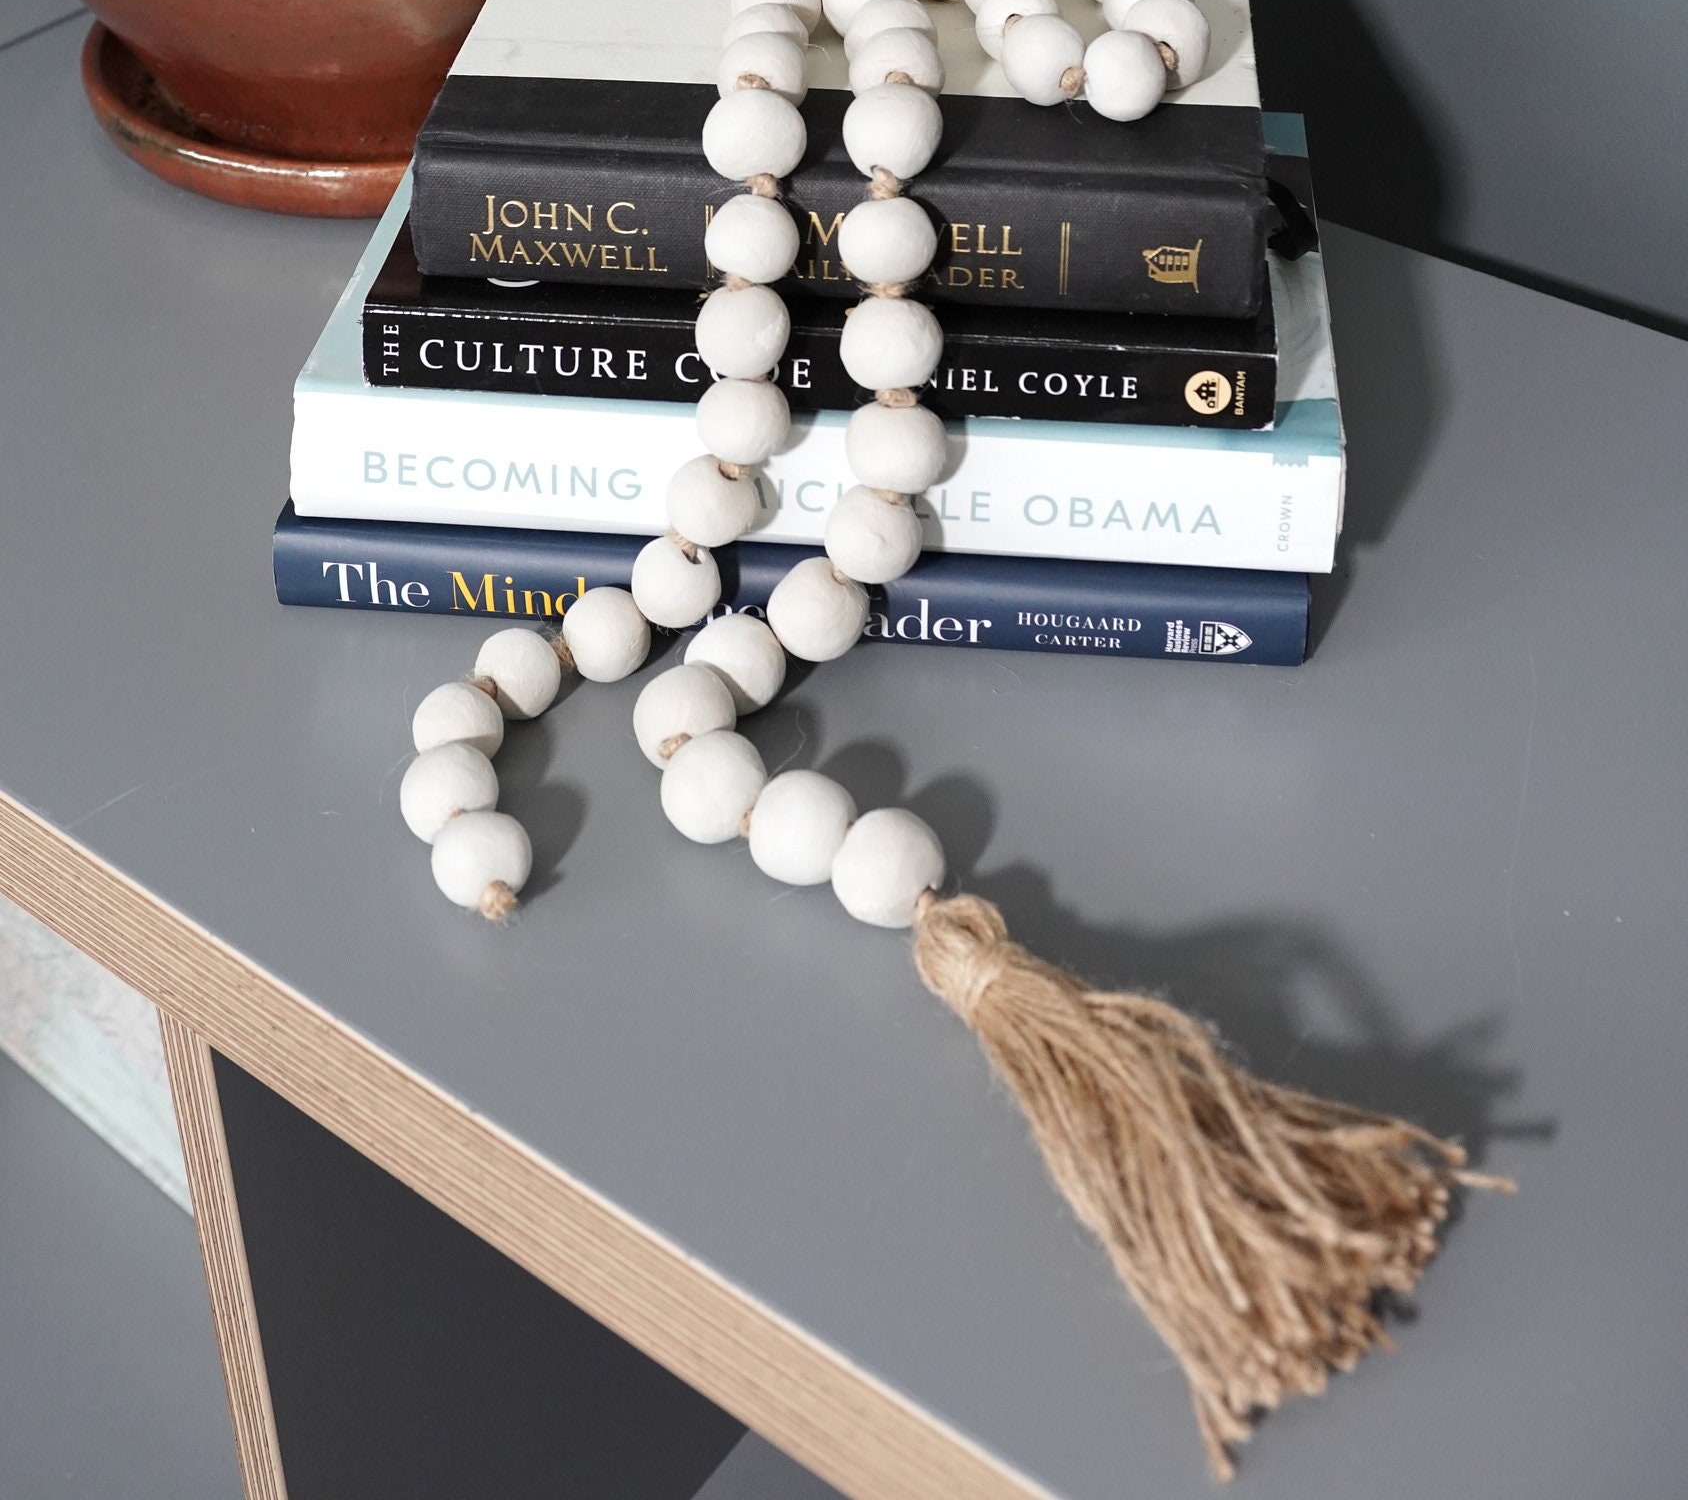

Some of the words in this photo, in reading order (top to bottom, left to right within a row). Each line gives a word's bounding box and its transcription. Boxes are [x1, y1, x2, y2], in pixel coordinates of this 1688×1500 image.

[482, 195, 593, 235] JOHN
[606, 202, 649, 236] C.
[469, 233, 668, 273] MAXWELL
[383, 324, 399, 376] THE
[419, 339, 648, 380] CULTURE
[675, 352, 811, 389] CE
[1018, 371, 1139, 400] COYLE
[1234, 370, 1247, 416] BANTAM
[362, 450, 643, 500] BECOMING
[1023, 494, 1222, 536] OBAMA
[1277, 495, 1293, 552] CROWN
[322, 562, 431, 608] The
[863, 598, 992, 643] ader
[1017, 611, 1142, 632] HOUGAARD
[1034, 633, 1122, 649] CARTER
[1164, 621, 1175, 652] Harvard
[1173, 619, 1184, 653] Business
[1181, 627, 1191, 653] Review
